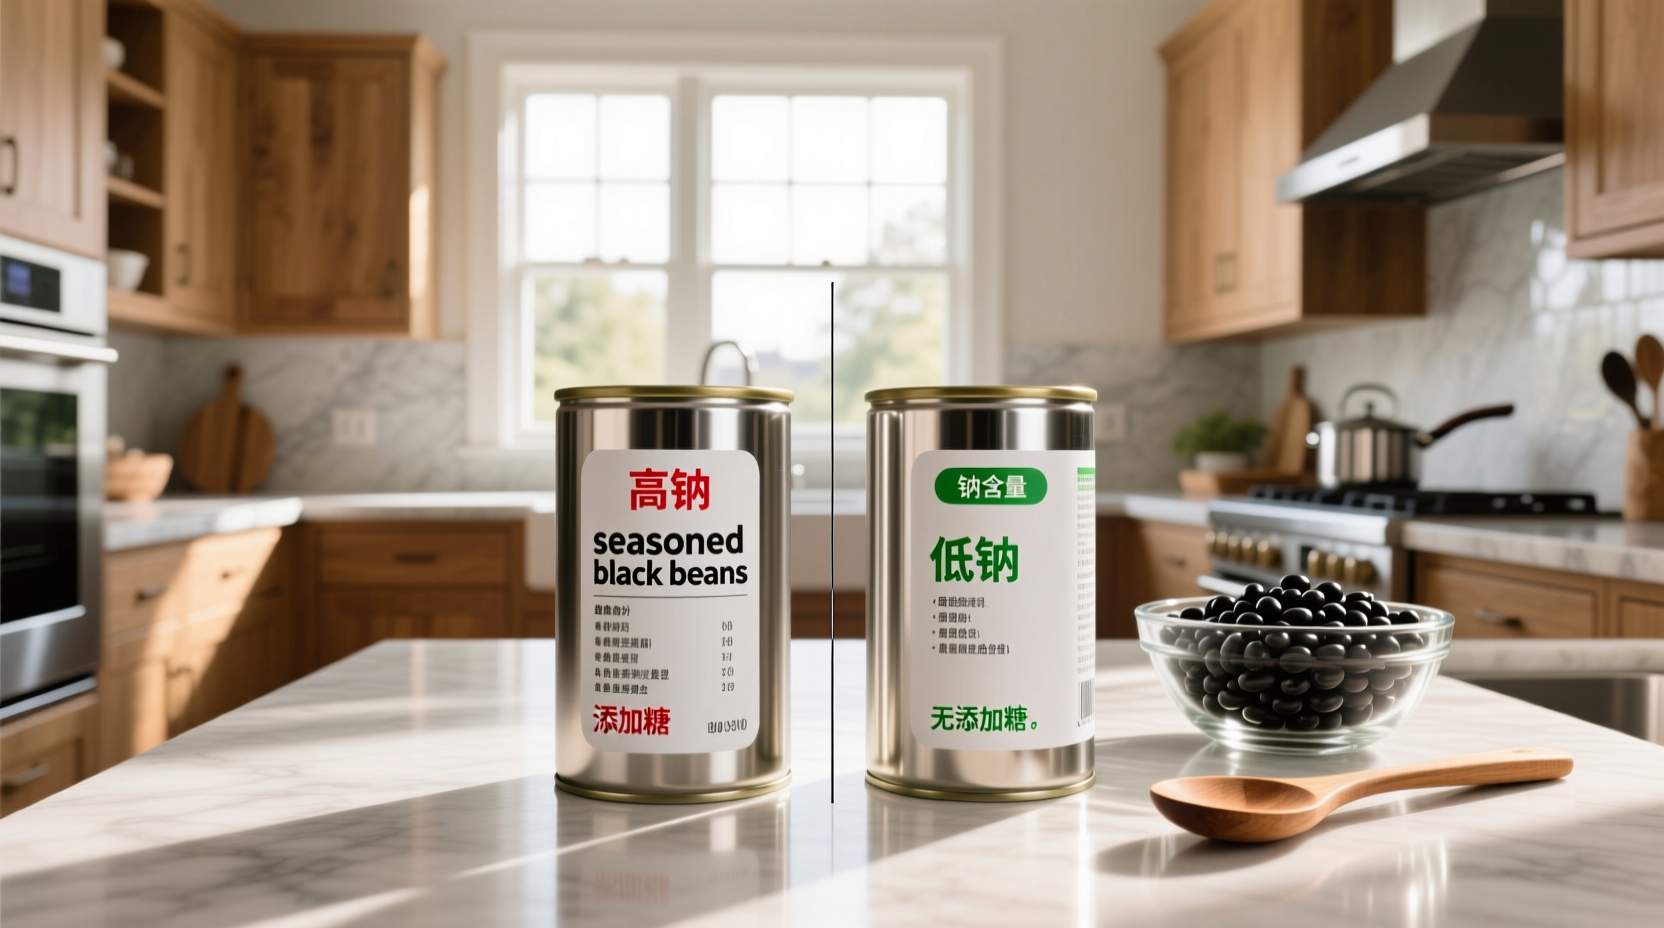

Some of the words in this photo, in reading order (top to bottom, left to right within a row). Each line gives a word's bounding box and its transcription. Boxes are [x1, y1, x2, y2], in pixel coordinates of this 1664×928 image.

[629, 467, 710, 511] 高钠
[957, 474, 1027, 499] 钠含量
[593, 524, 744, 556] seasoned
[593, 558, 664, 587] black
[669, 559, 749, 587] beans
[929, 535, 1019, 583] 低钠
[592, 704, 671, 736] 添加糖
